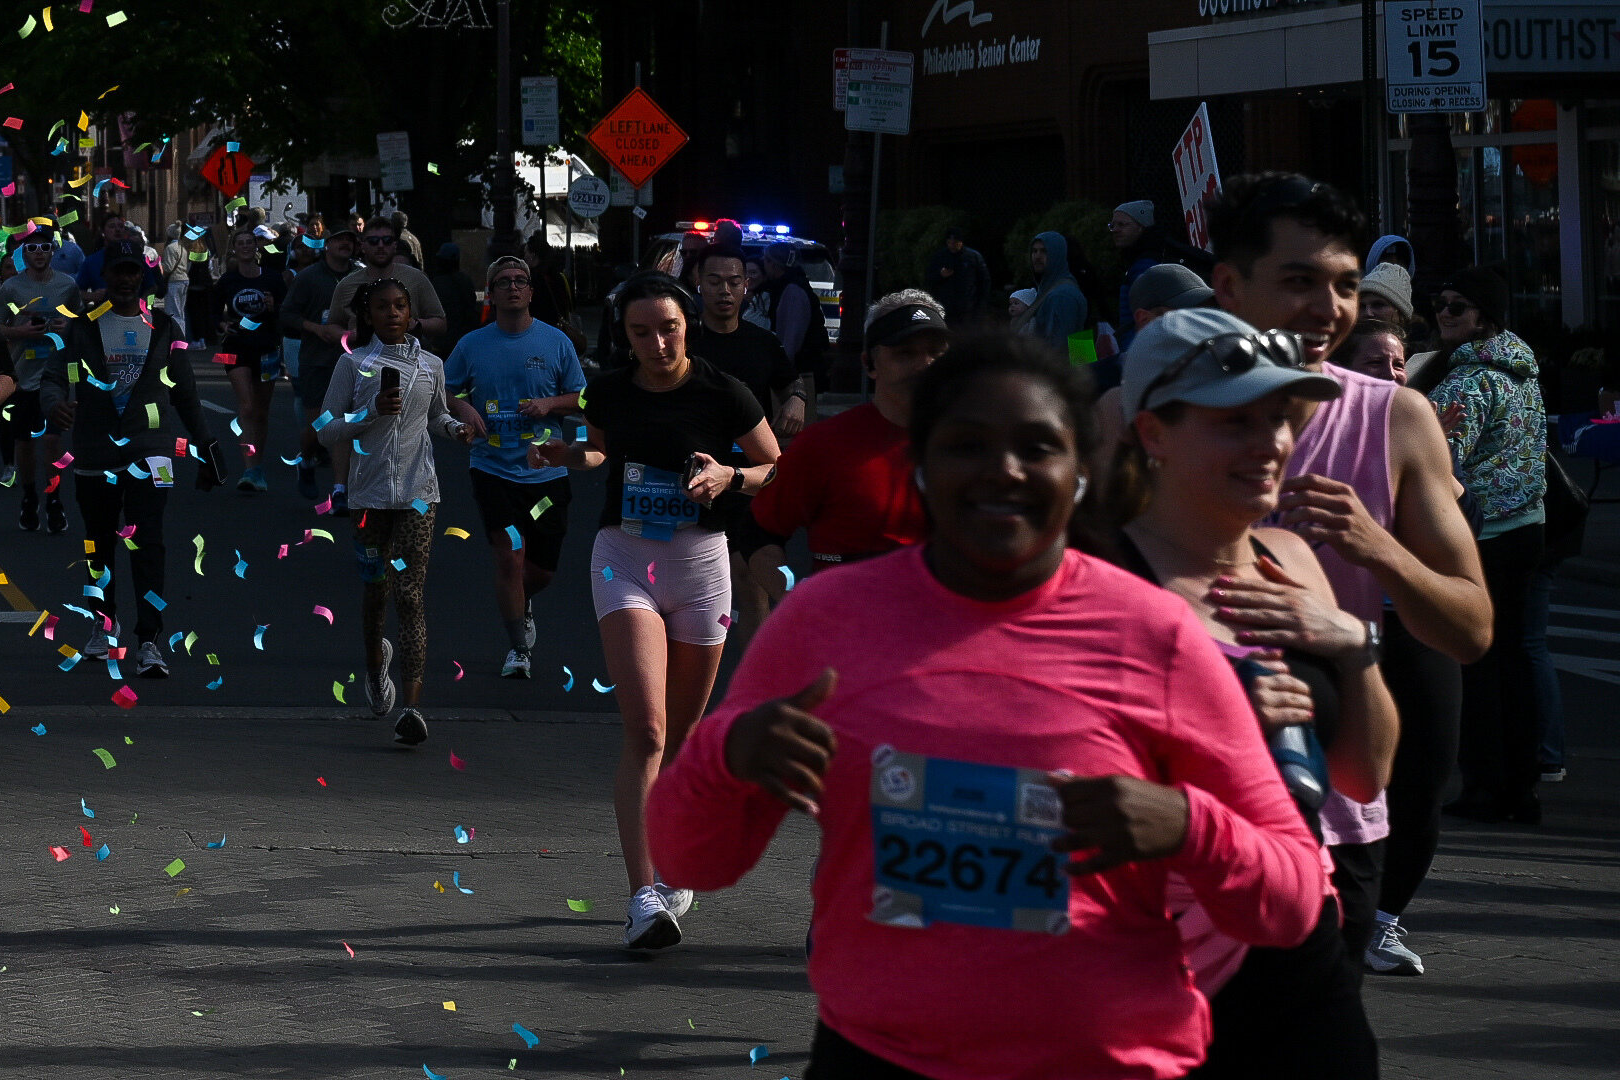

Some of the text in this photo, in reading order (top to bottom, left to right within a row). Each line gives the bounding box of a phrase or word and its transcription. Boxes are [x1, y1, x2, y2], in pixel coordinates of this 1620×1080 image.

[1400, 7, 1464, 22] SPEED
[1406, 23, 1458, 38] LIMIT
[923, 33, 1042, 78] Philadelphia Senior Center
[1407, 39, 1461, 78] 15
[1394, 86, 1472, 97] DURING OPENIN
[1391, 98, 1426, 108] CLOSING
[1448, 97, 1481, 107] RECESS
[609, 119, 671, 136] LEFT LANE
[615, 137, 660, 151] CLOSED
[619, 154, 657, 168] AHEAD
[627, 485, 651, 494] BROAD
[627, 495, 696, 517] 19966
[879, 811, 943, 832] BROAD
[947, 819, 1013, 839] STREET
[880, 833, 1062, 899] 22674
